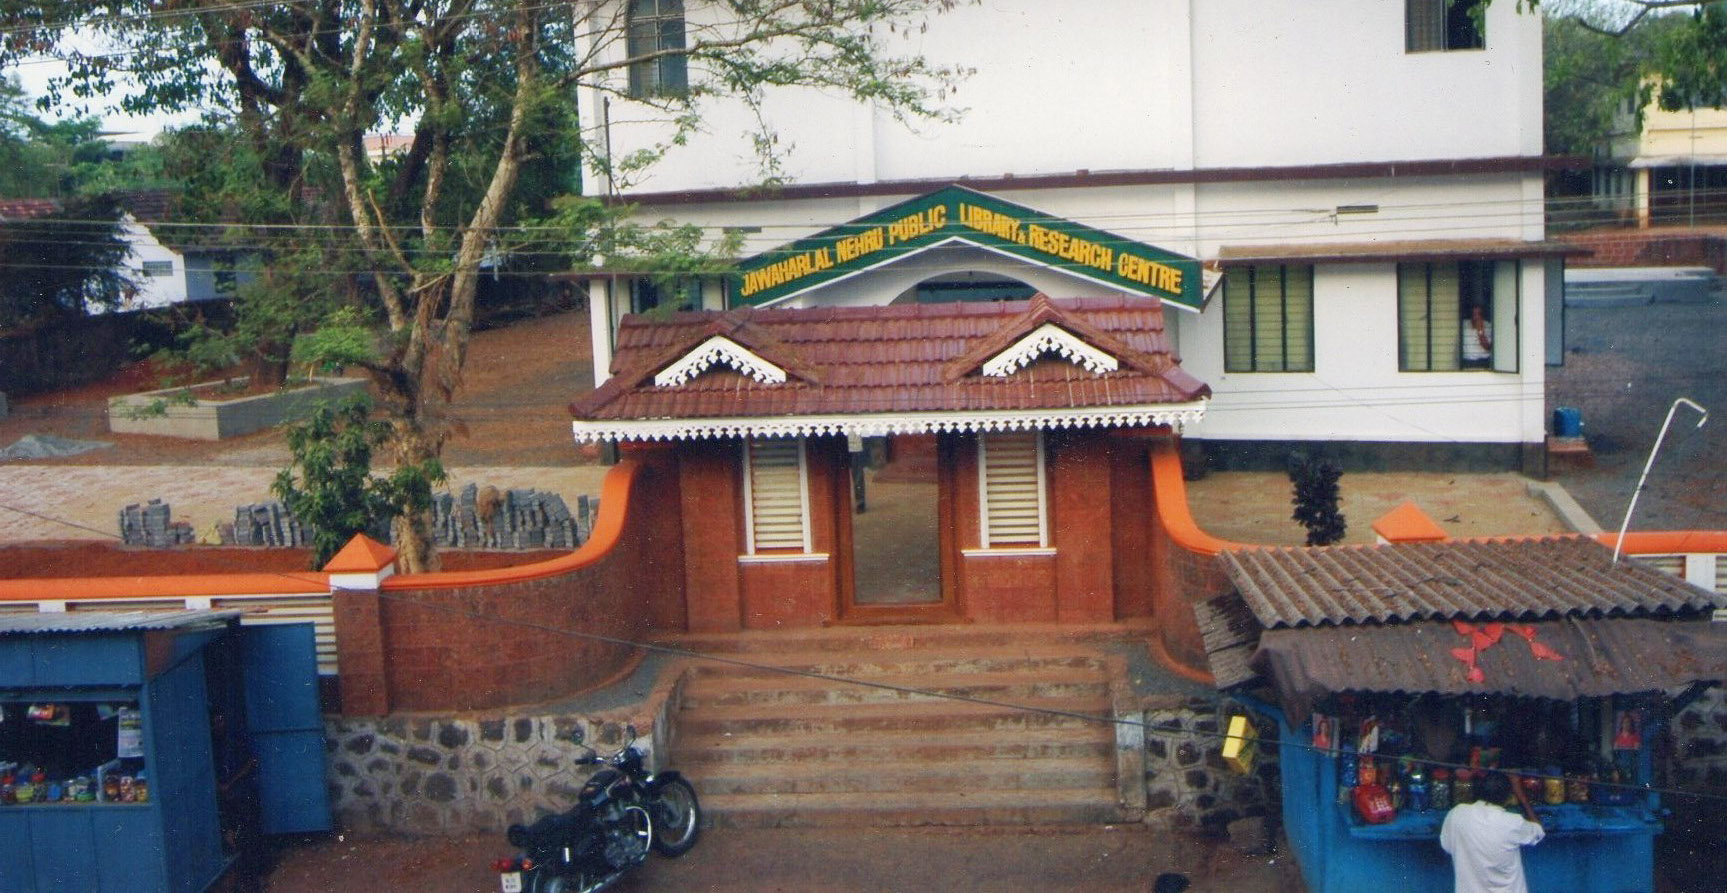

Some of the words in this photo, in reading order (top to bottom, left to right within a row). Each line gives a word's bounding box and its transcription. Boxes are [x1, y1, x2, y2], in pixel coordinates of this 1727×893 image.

[741, 247, 833, 296] JAWAHARLAL
[836, 228, 883, 263] NEHRU
[889, 205, 946, 245] PUBLIC
[960, 203, 1021, 241] LIBRARY
[1029, 224, 1112, 271] RESEARCH
[1118, 252, 1183, 294] CENTRE
